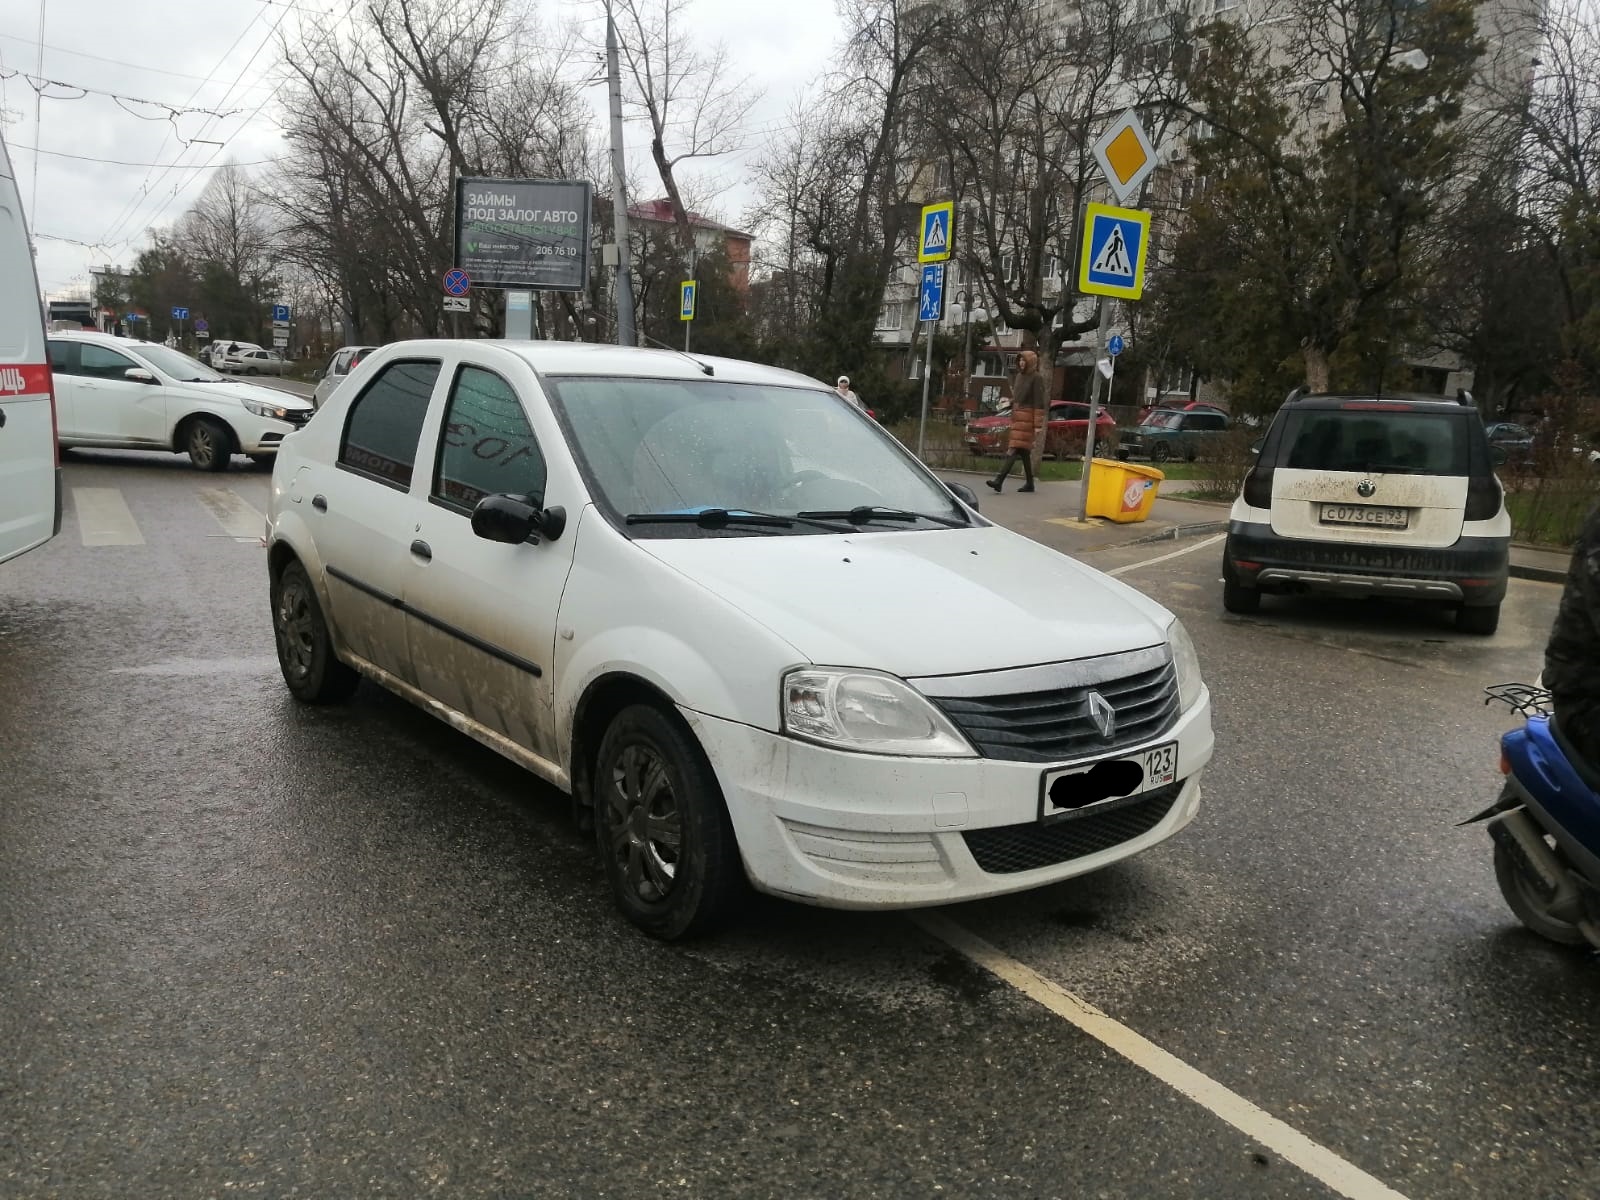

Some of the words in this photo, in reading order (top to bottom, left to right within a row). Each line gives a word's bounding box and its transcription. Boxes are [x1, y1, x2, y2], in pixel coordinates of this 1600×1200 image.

[468, 191, 516, 207] ЗАЙМЫ
[468, 208, 496, 222] ПОД
[498, 209, 541, 221] ЗАЛОГ
[543, 211, 578, 223] АВТО
[536, 246, 553, 255] 206
[1146, 748, 1172, 777] 123
[1150, 773, 1164, 785] RUS
